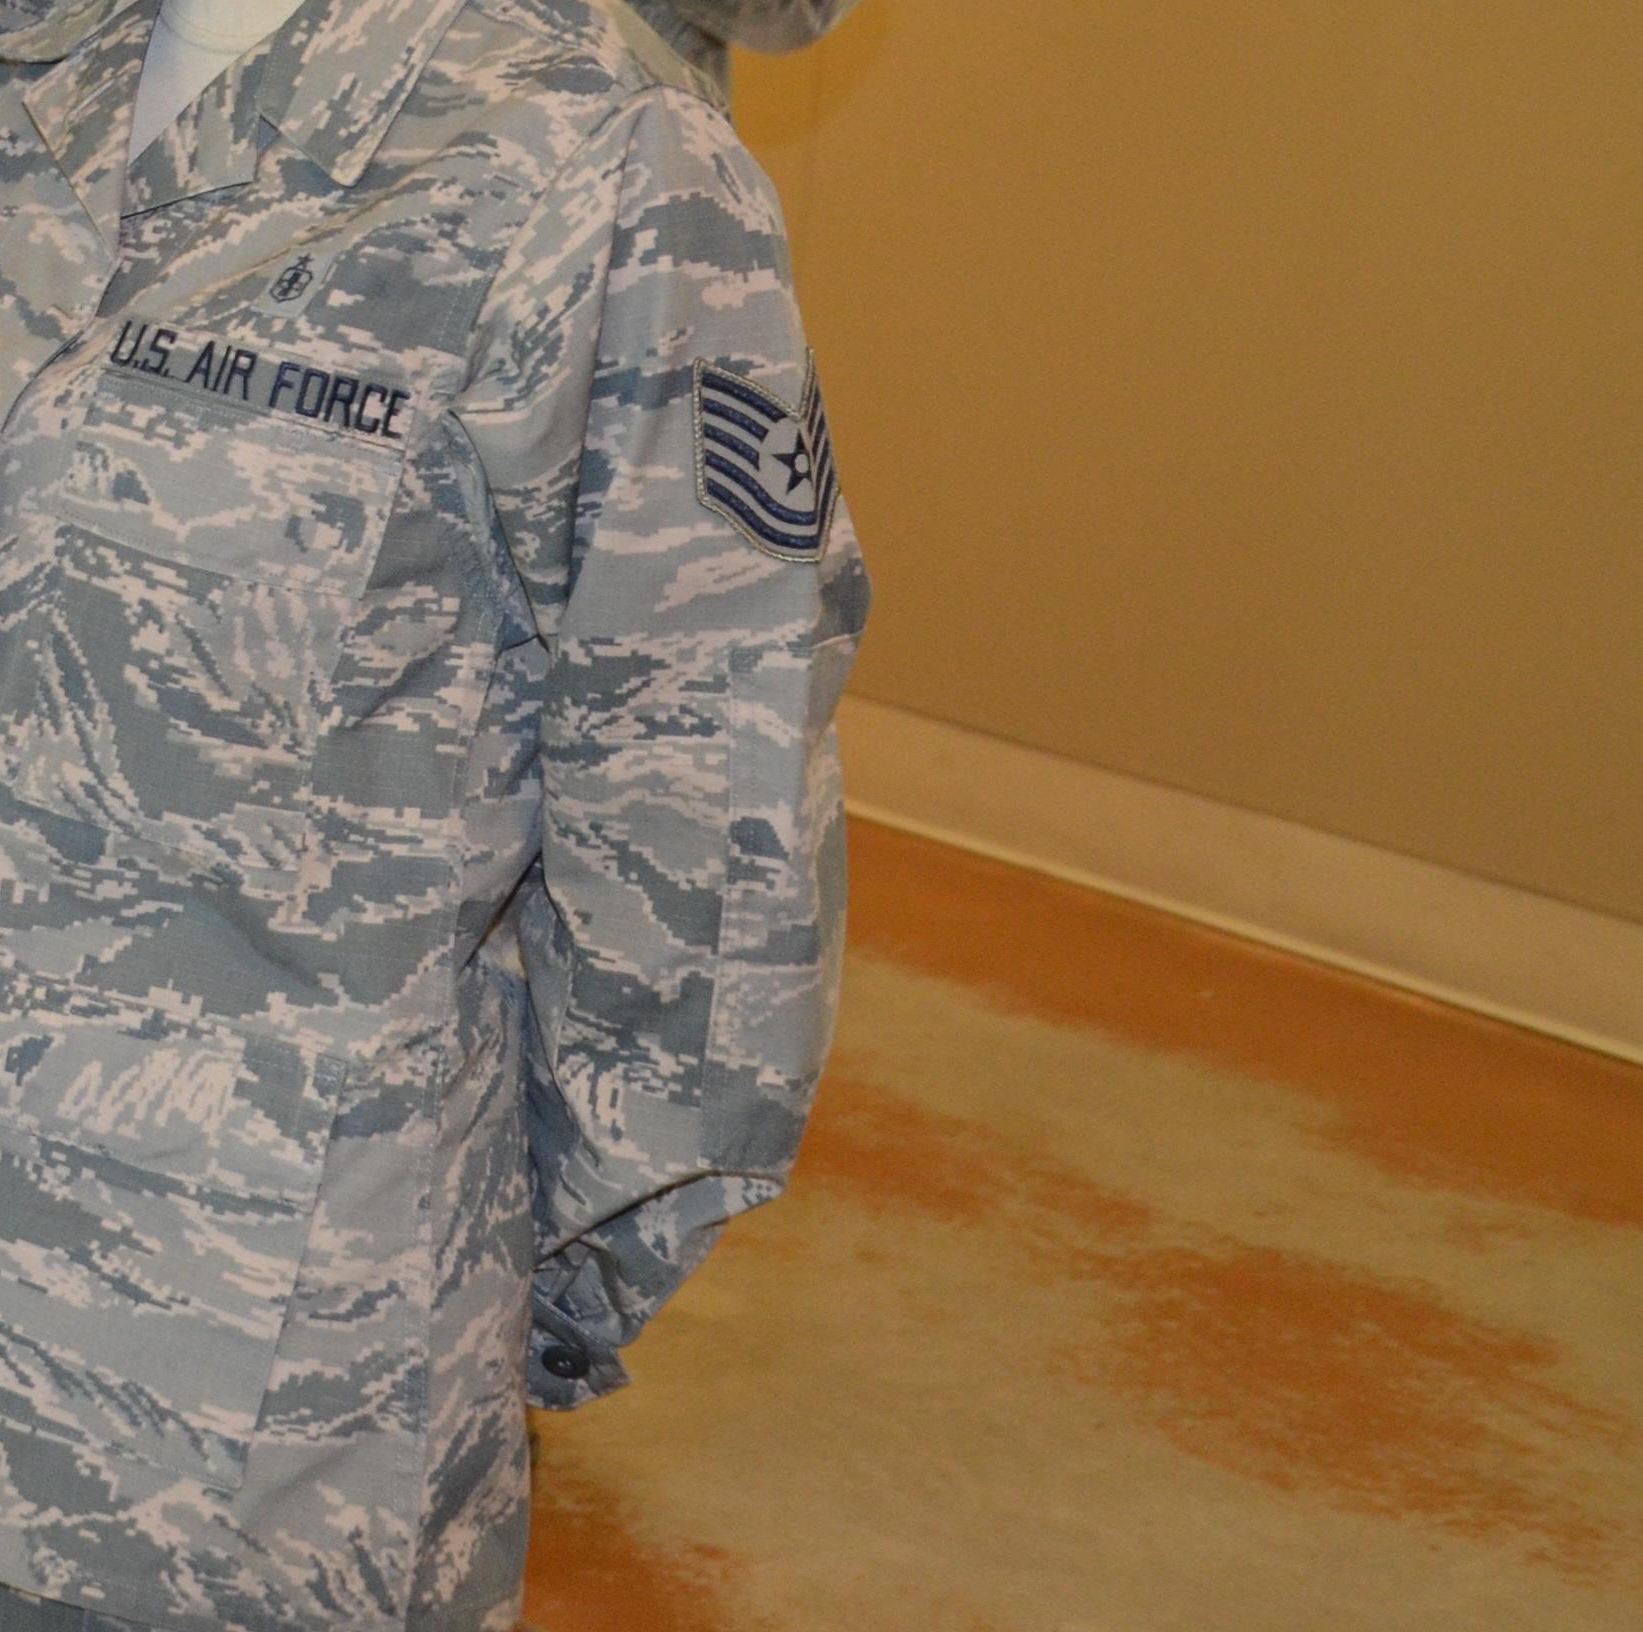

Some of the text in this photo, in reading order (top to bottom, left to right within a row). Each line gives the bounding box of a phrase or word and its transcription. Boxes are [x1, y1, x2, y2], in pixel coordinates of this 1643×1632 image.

[109, 320, 412, 440] U.S. AIR FORCE
